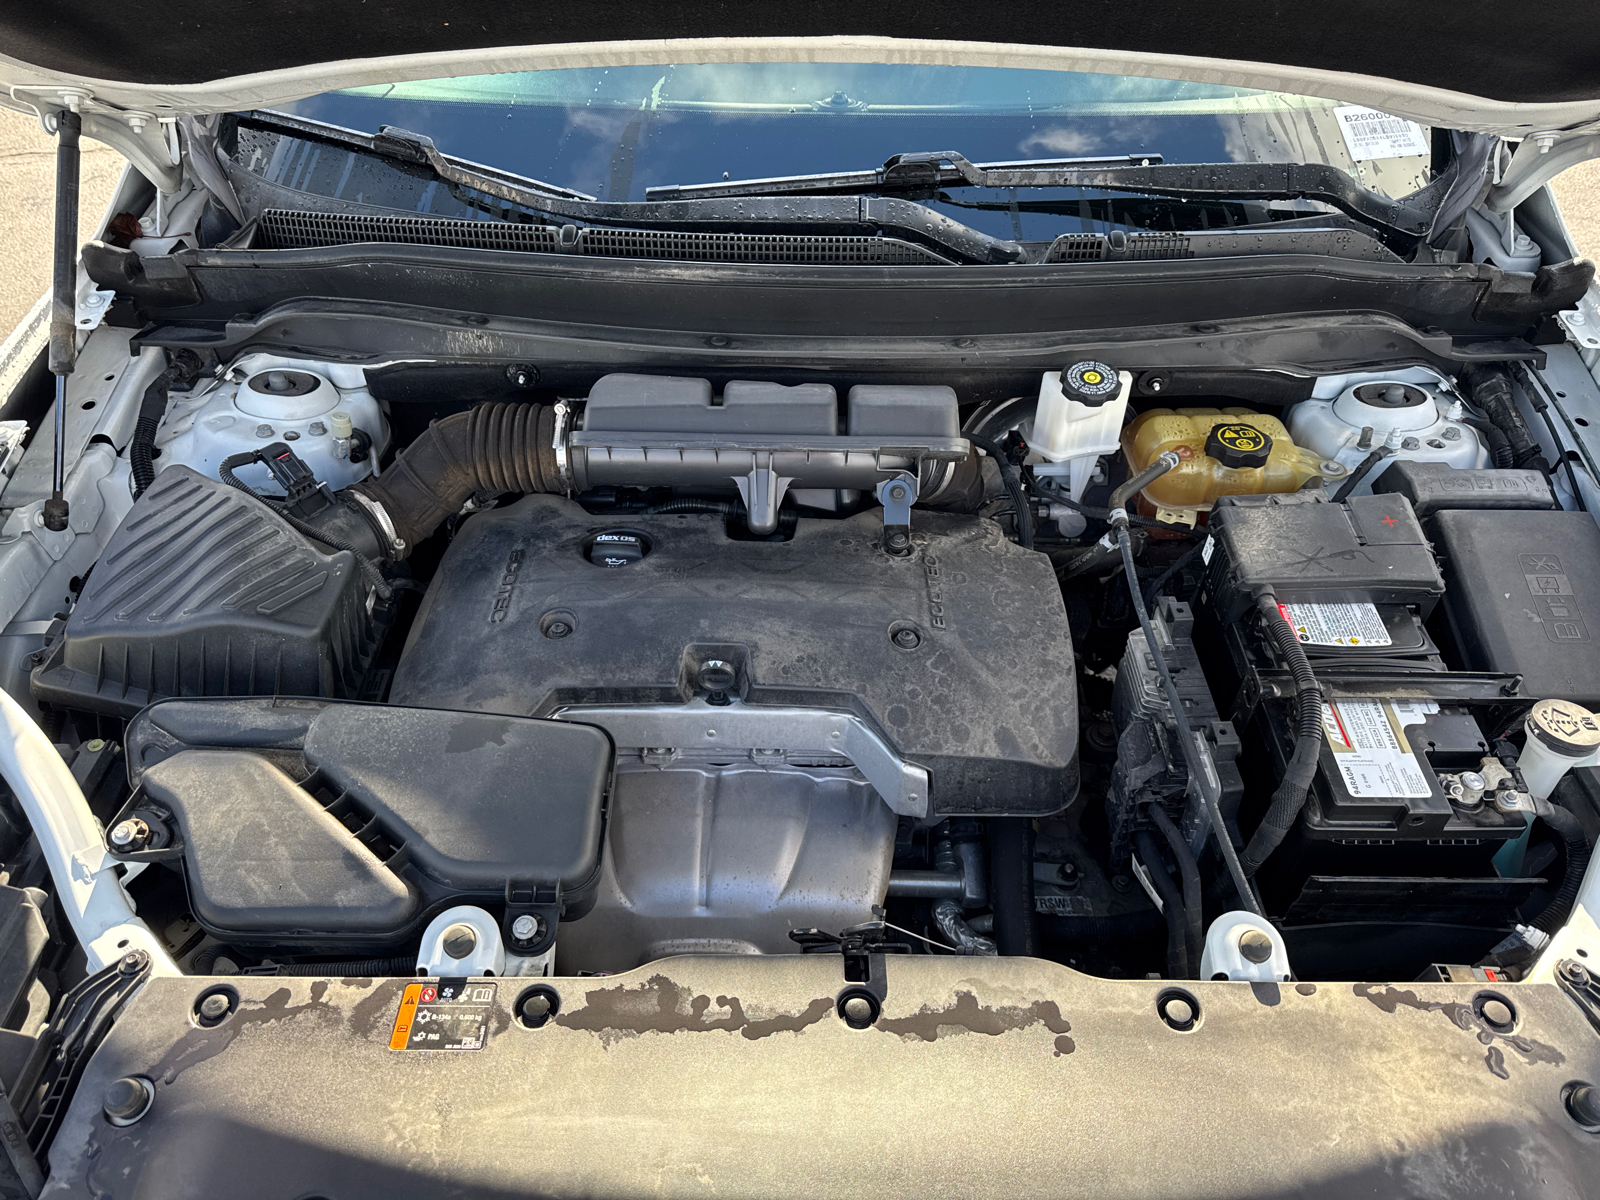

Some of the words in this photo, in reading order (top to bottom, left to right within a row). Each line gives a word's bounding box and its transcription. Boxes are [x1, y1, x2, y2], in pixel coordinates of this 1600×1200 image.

[596, 534, 636, 542] dexos
[490, 548, 526, 623] ECOTEC
[922, 554, 946, 631] ECOTEC
[1344, 766, 1361, 794] 94RAGM
